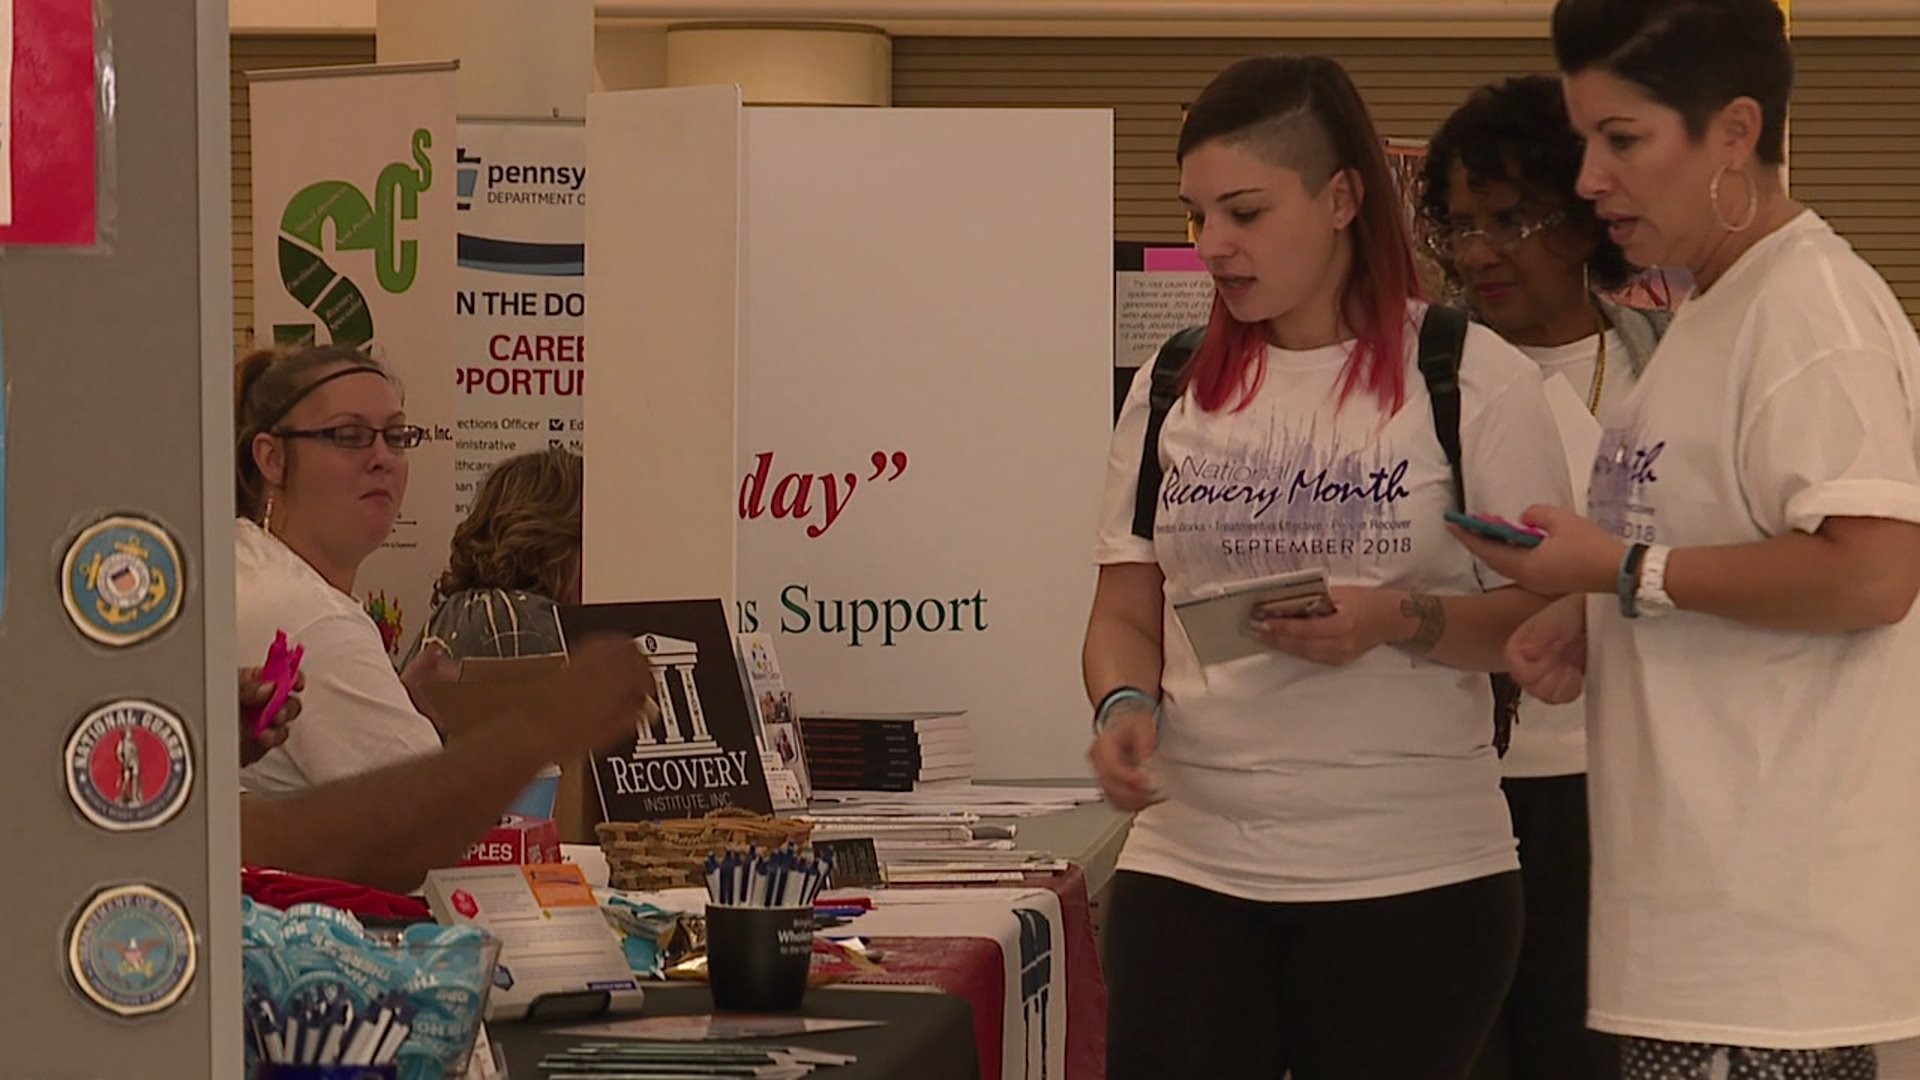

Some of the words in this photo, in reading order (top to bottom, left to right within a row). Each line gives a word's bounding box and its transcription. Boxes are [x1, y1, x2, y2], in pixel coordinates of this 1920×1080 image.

[488, 165, 585, 190] pennsy
[487, 192, 573, 206] DEPARTMENT
[482, 293, 537, 316] THE
[456, 420, 498, 430] ections
[501, 418, 540, 431] Officer
[1180, 454, 1292, 482] National
[1162, 464, 1282, 519] Recovery
[1287, 459, 1411, 505] Month
[1369, 519, 1412, 531] Recover
[1221, 538, 1354, 556] SEPTEMBER
[1363, 537, 1412, 555] 2018
[780, 584, 989, 647] Support
[607, 751, 750, 794] RECOVERY
